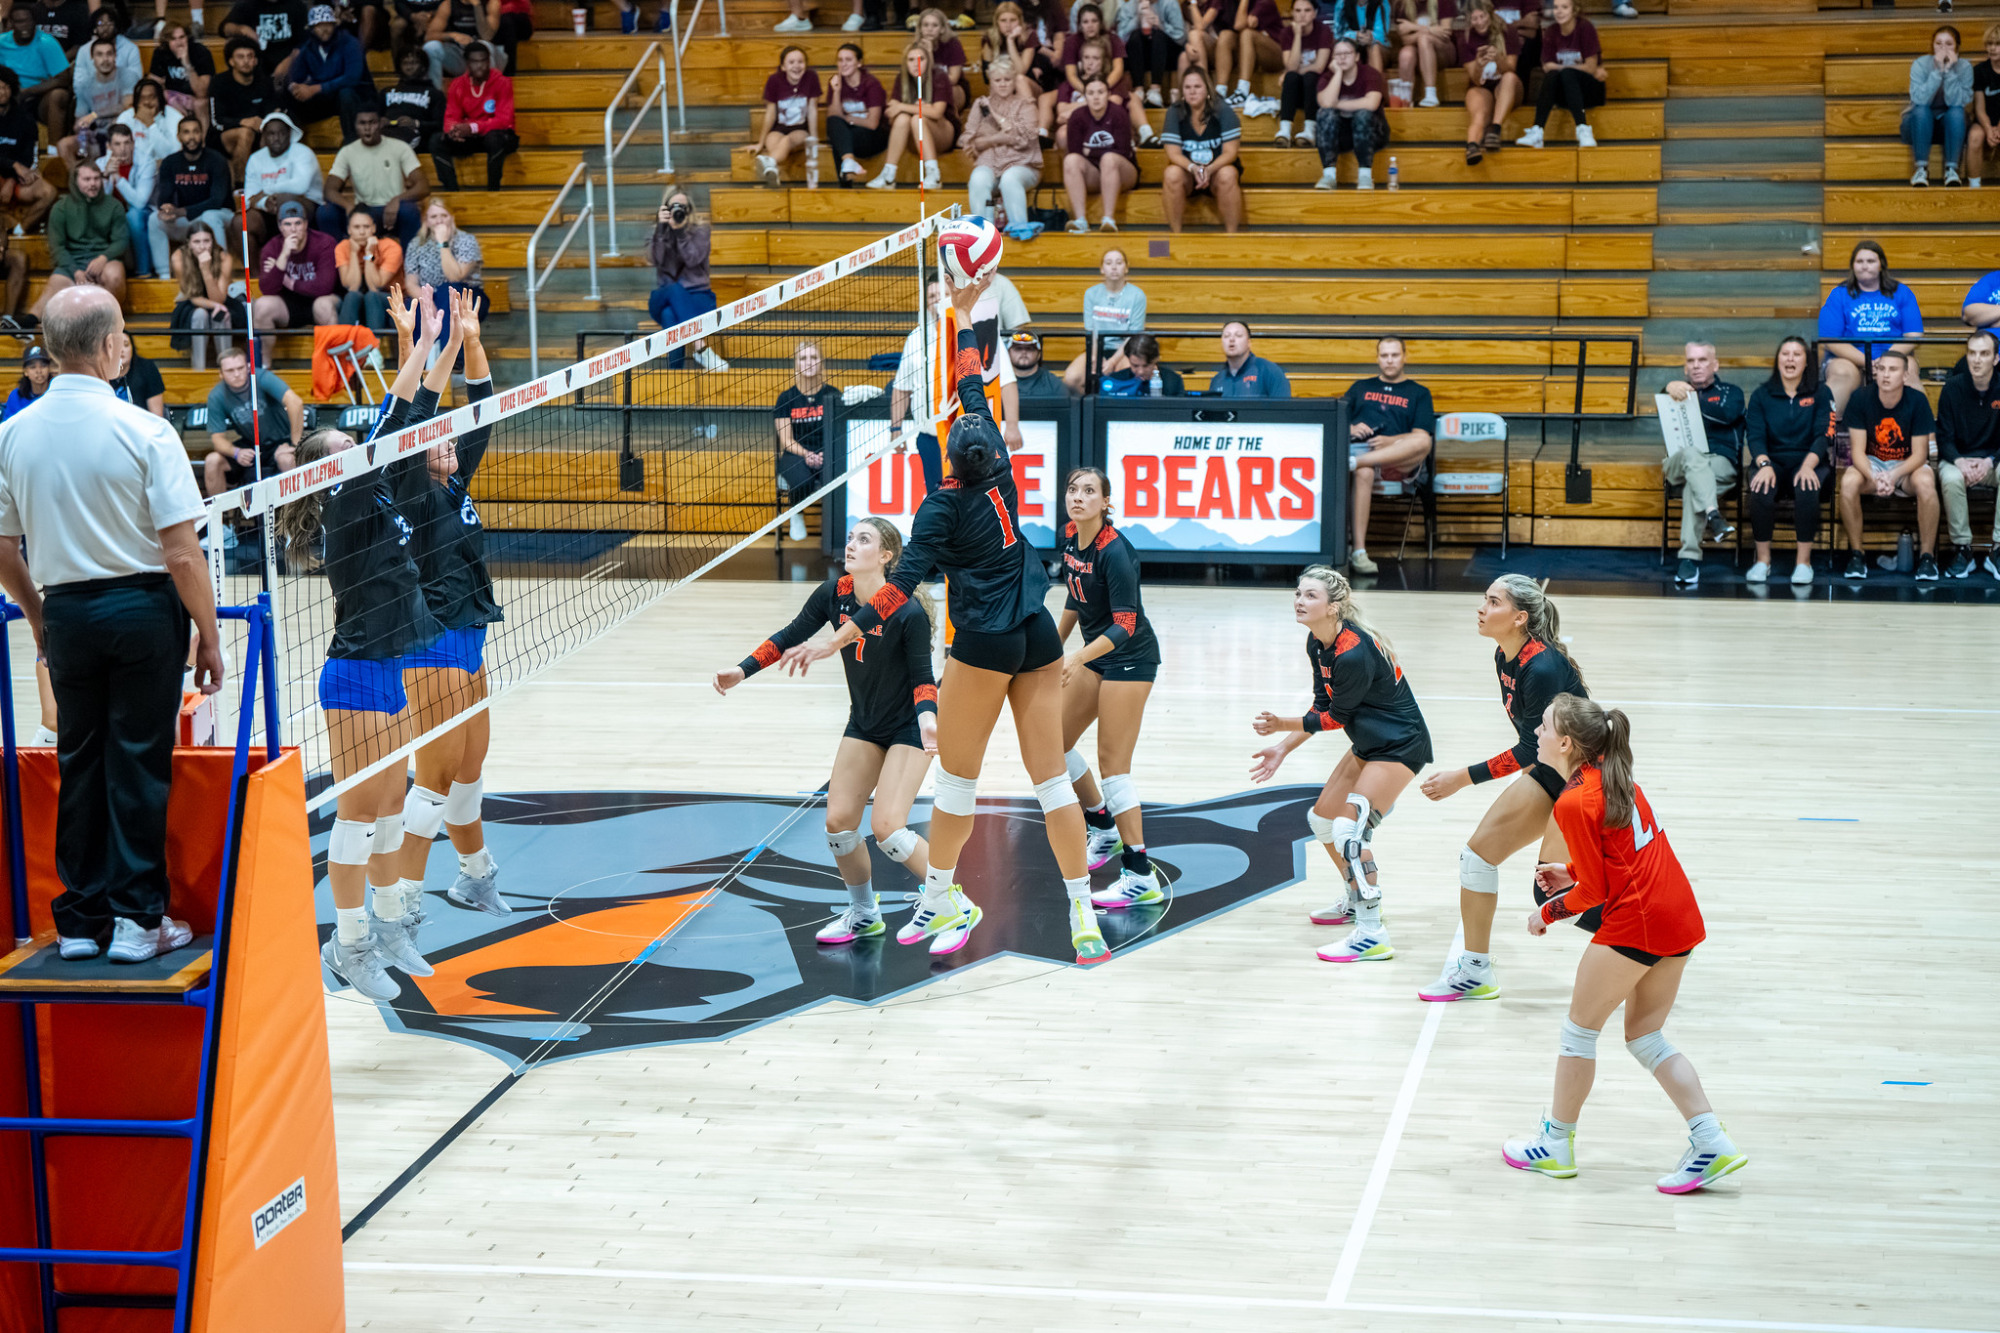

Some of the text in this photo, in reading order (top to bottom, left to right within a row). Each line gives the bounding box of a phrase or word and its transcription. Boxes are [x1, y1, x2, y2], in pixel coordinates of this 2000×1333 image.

[588, 348, 631, 378] UPIKE VOLLEYBALL
[500, 379, 548, 413] UPIKE VOLLEYBALL
[1364, 391, 1409, 408] CULTURE
[398, 416, 453, 453] UPIKE VOLLEYBALL
[1446, 417, 1497, 436] UPIKE
[1174, 436, 1263, 451] HOME OF THE
[279, 457, 344, 498] UPIKE VOLLEYBALL
[1121, 455, 1315, 520] BEARS
[985, 486, 1018, 549] 1
[1068, 572, 1088, 603] 11
[855, 636, 866, 663] 7
